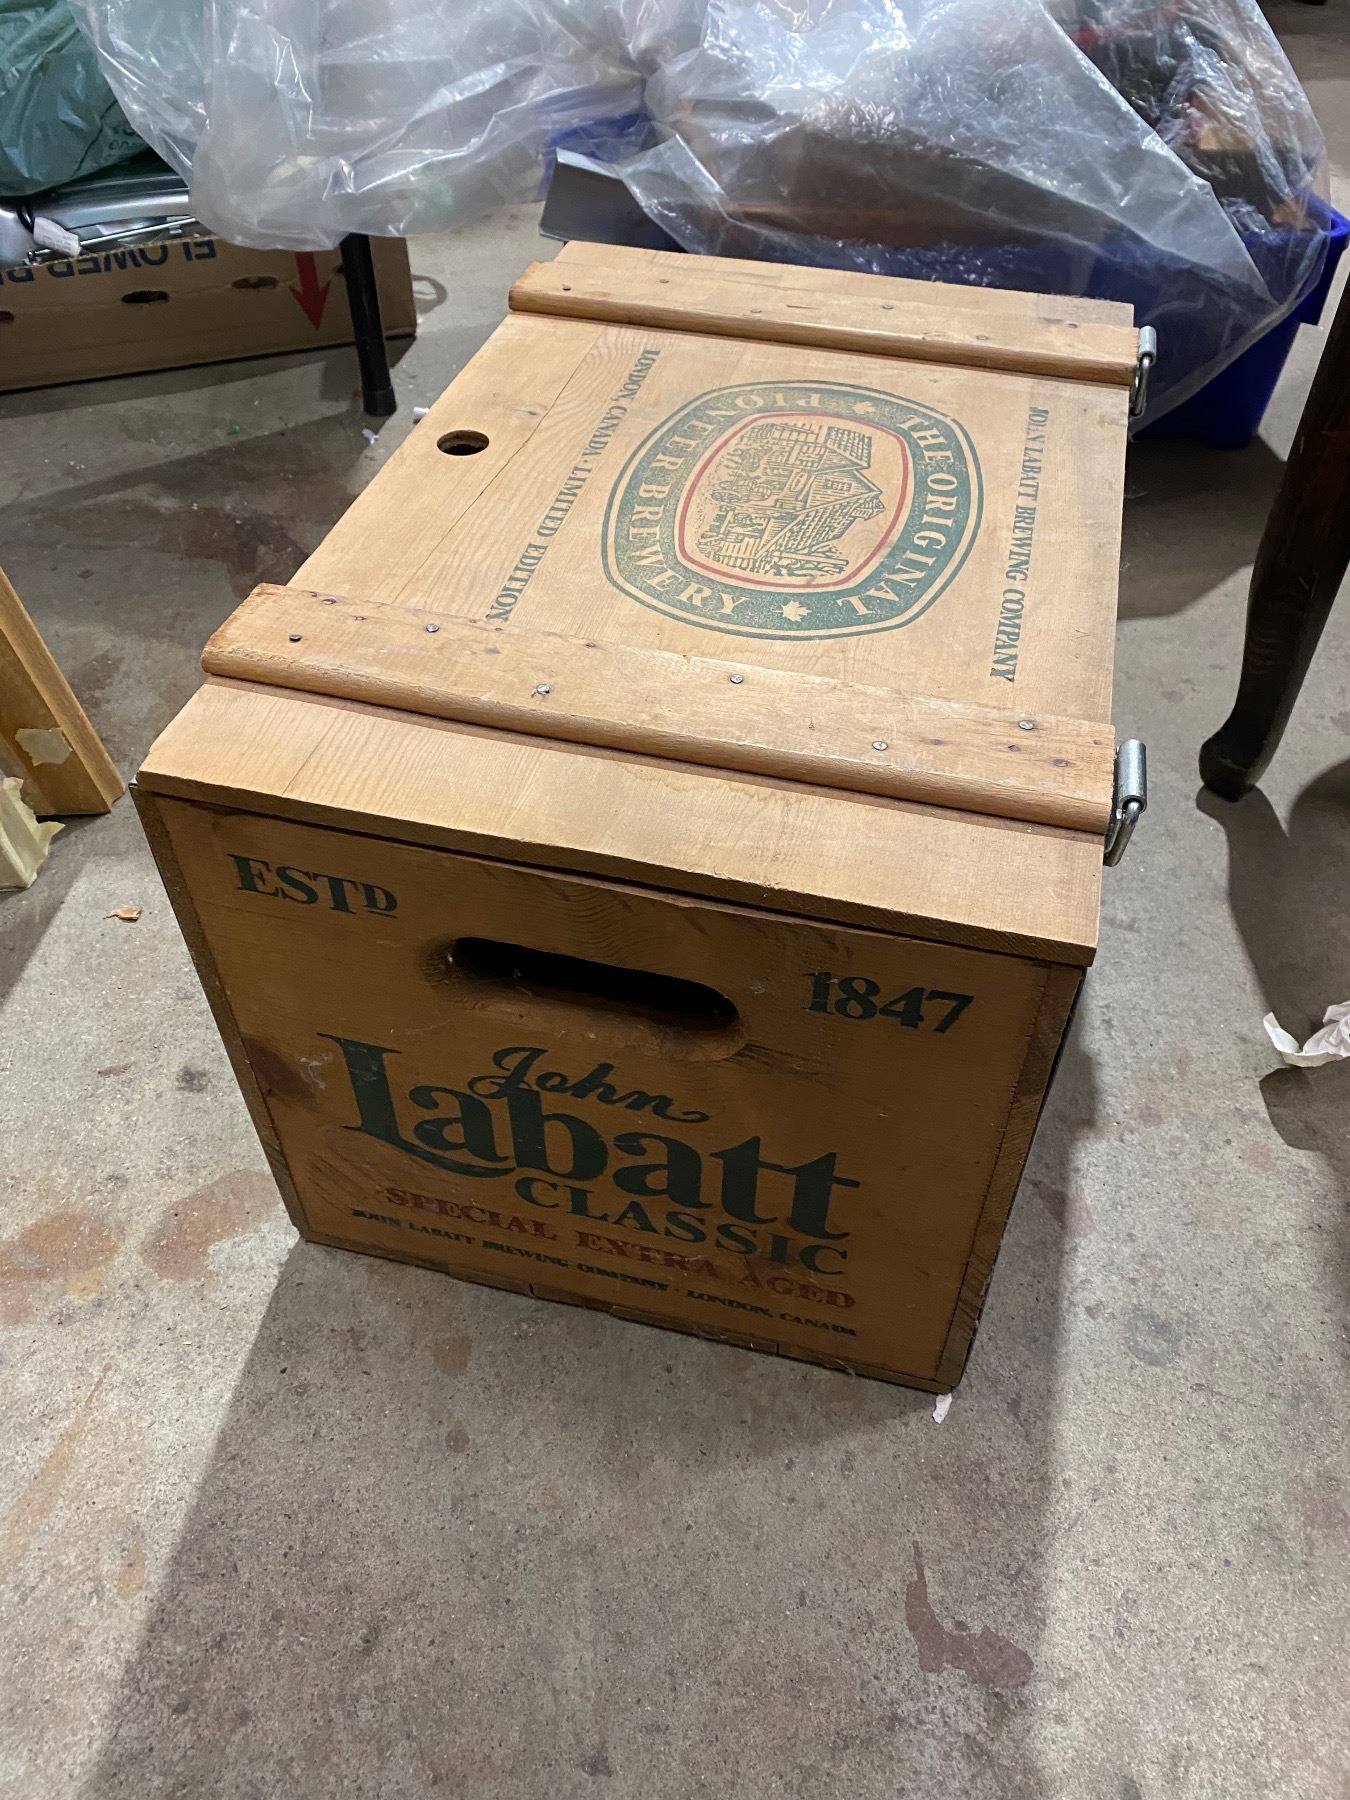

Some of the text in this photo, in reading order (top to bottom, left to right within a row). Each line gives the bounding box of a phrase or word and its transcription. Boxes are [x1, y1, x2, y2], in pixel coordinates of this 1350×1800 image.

[651, 392, 824, 471] PIONEER
[1018, 447, 1043, 501] LABATT
[485, 350, 661, 622] LONDON, CANADA LIMITED EDITION
[835, 414, 959, 616] THE ORIGINAL
[628, 482, 751, 616] BREWERY
[1005, 504, 1036, 581] BREWING
[990, 588, 1025, 682] COMPANY
[801, 971, 975, 1034] 1847
[467, 1046, 710, 1123] John
[316, 1032, 861, 1240] Labatt
[385, 1187, 857, 1309] SPECIAL EXTRA AGED
[408, 1222, 476, 1245] LABATT
[515, 1177, 848, 1275] CLASSIC
